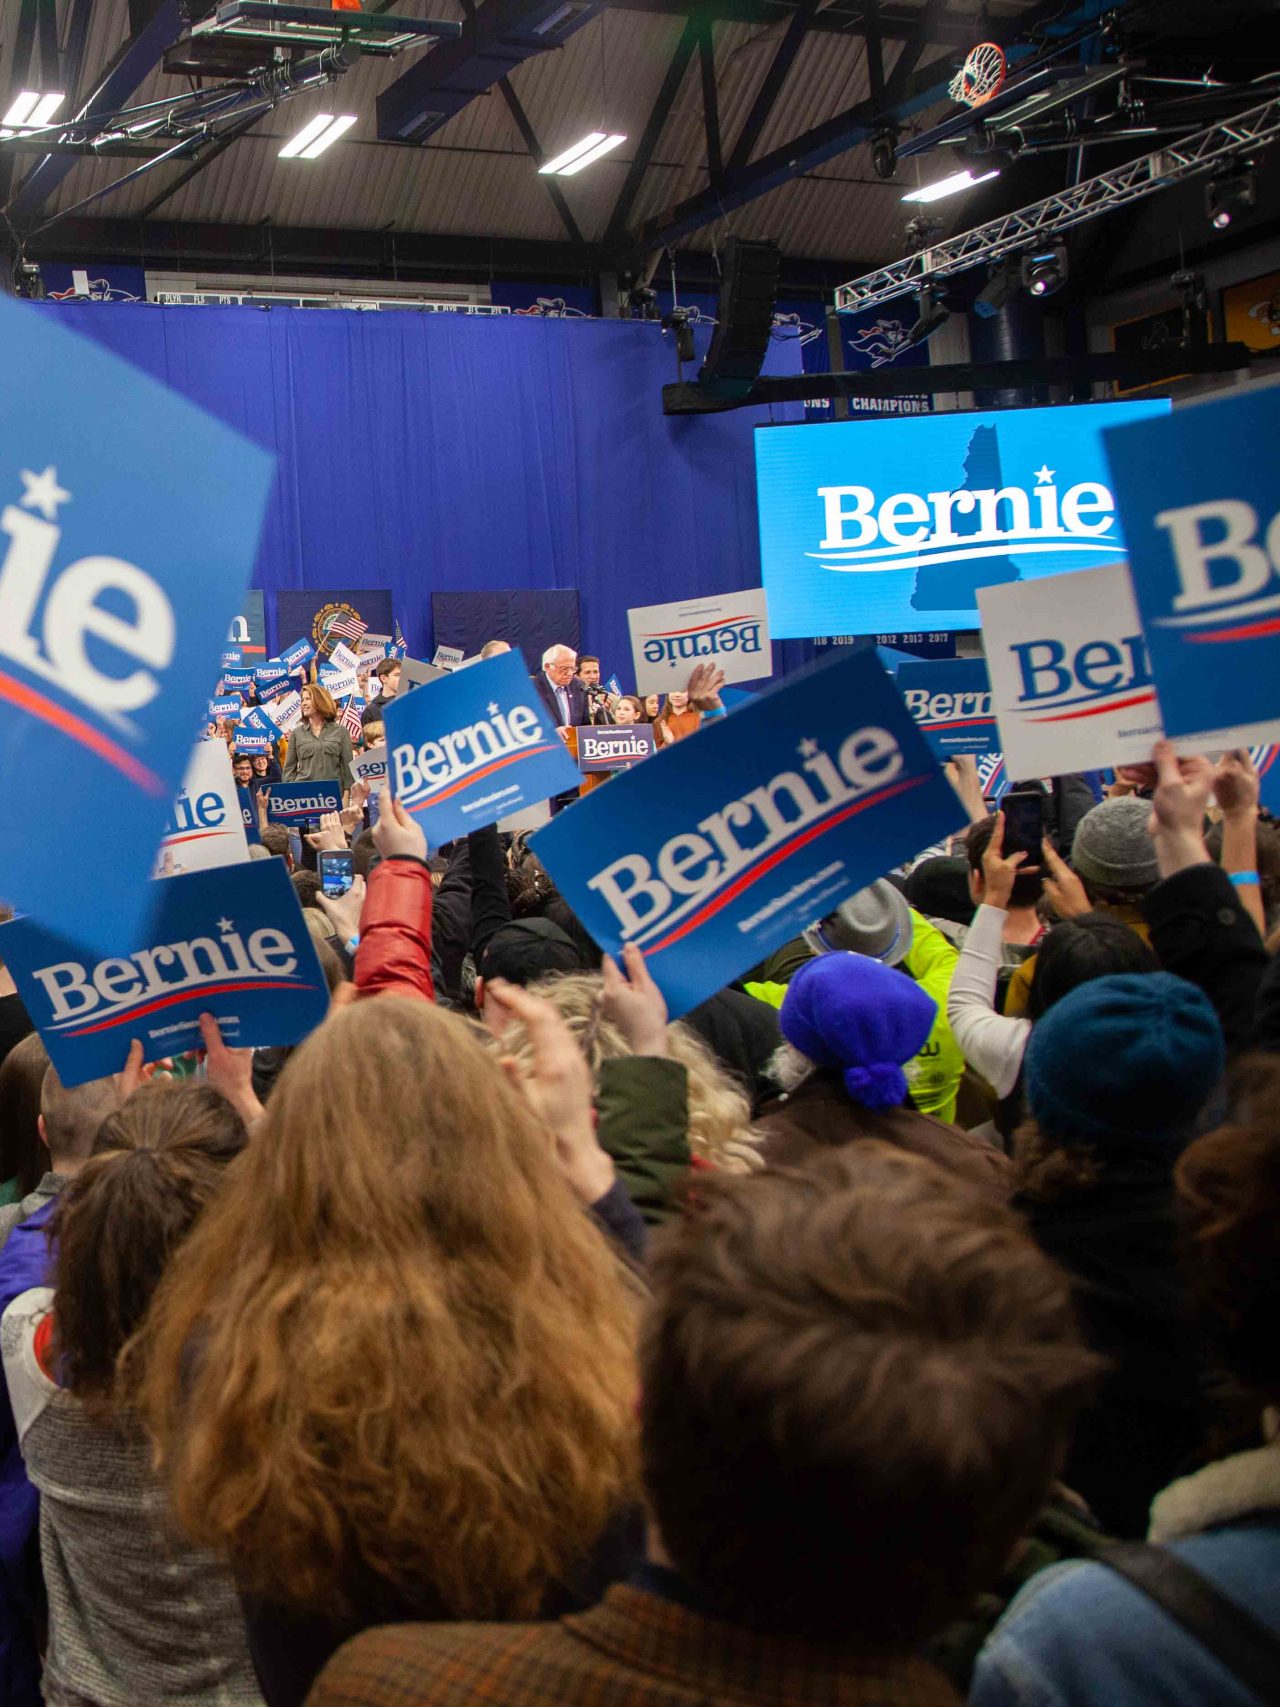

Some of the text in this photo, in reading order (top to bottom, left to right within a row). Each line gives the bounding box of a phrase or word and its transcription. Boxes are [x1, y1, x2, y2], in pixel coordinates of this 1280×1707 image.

[166, 293, 181, 303] PLYR
[194, 295, 205, 304] FLS
[852, 397, 929, 412] CHAMPIONS
[818, 465, 1115, 549] Bernie
[644, 624, 762, 668] Bernie
[224, 673, 251, 682] Bernie
[256, 667, 287, 677] Bernie
[260, 680, 290, 698] Bernie
[325, 677, 355, 691] Bernie
[236, 733, 267, 745] Bernie
[583, 735, 648, 757] Bernie
[393, 701, 543, 797] Bernie
[270, 794, 337, 812] Bernie
[588, 726, 903, 938] Bernie
[32, 917, 297, 1021] Bernie
